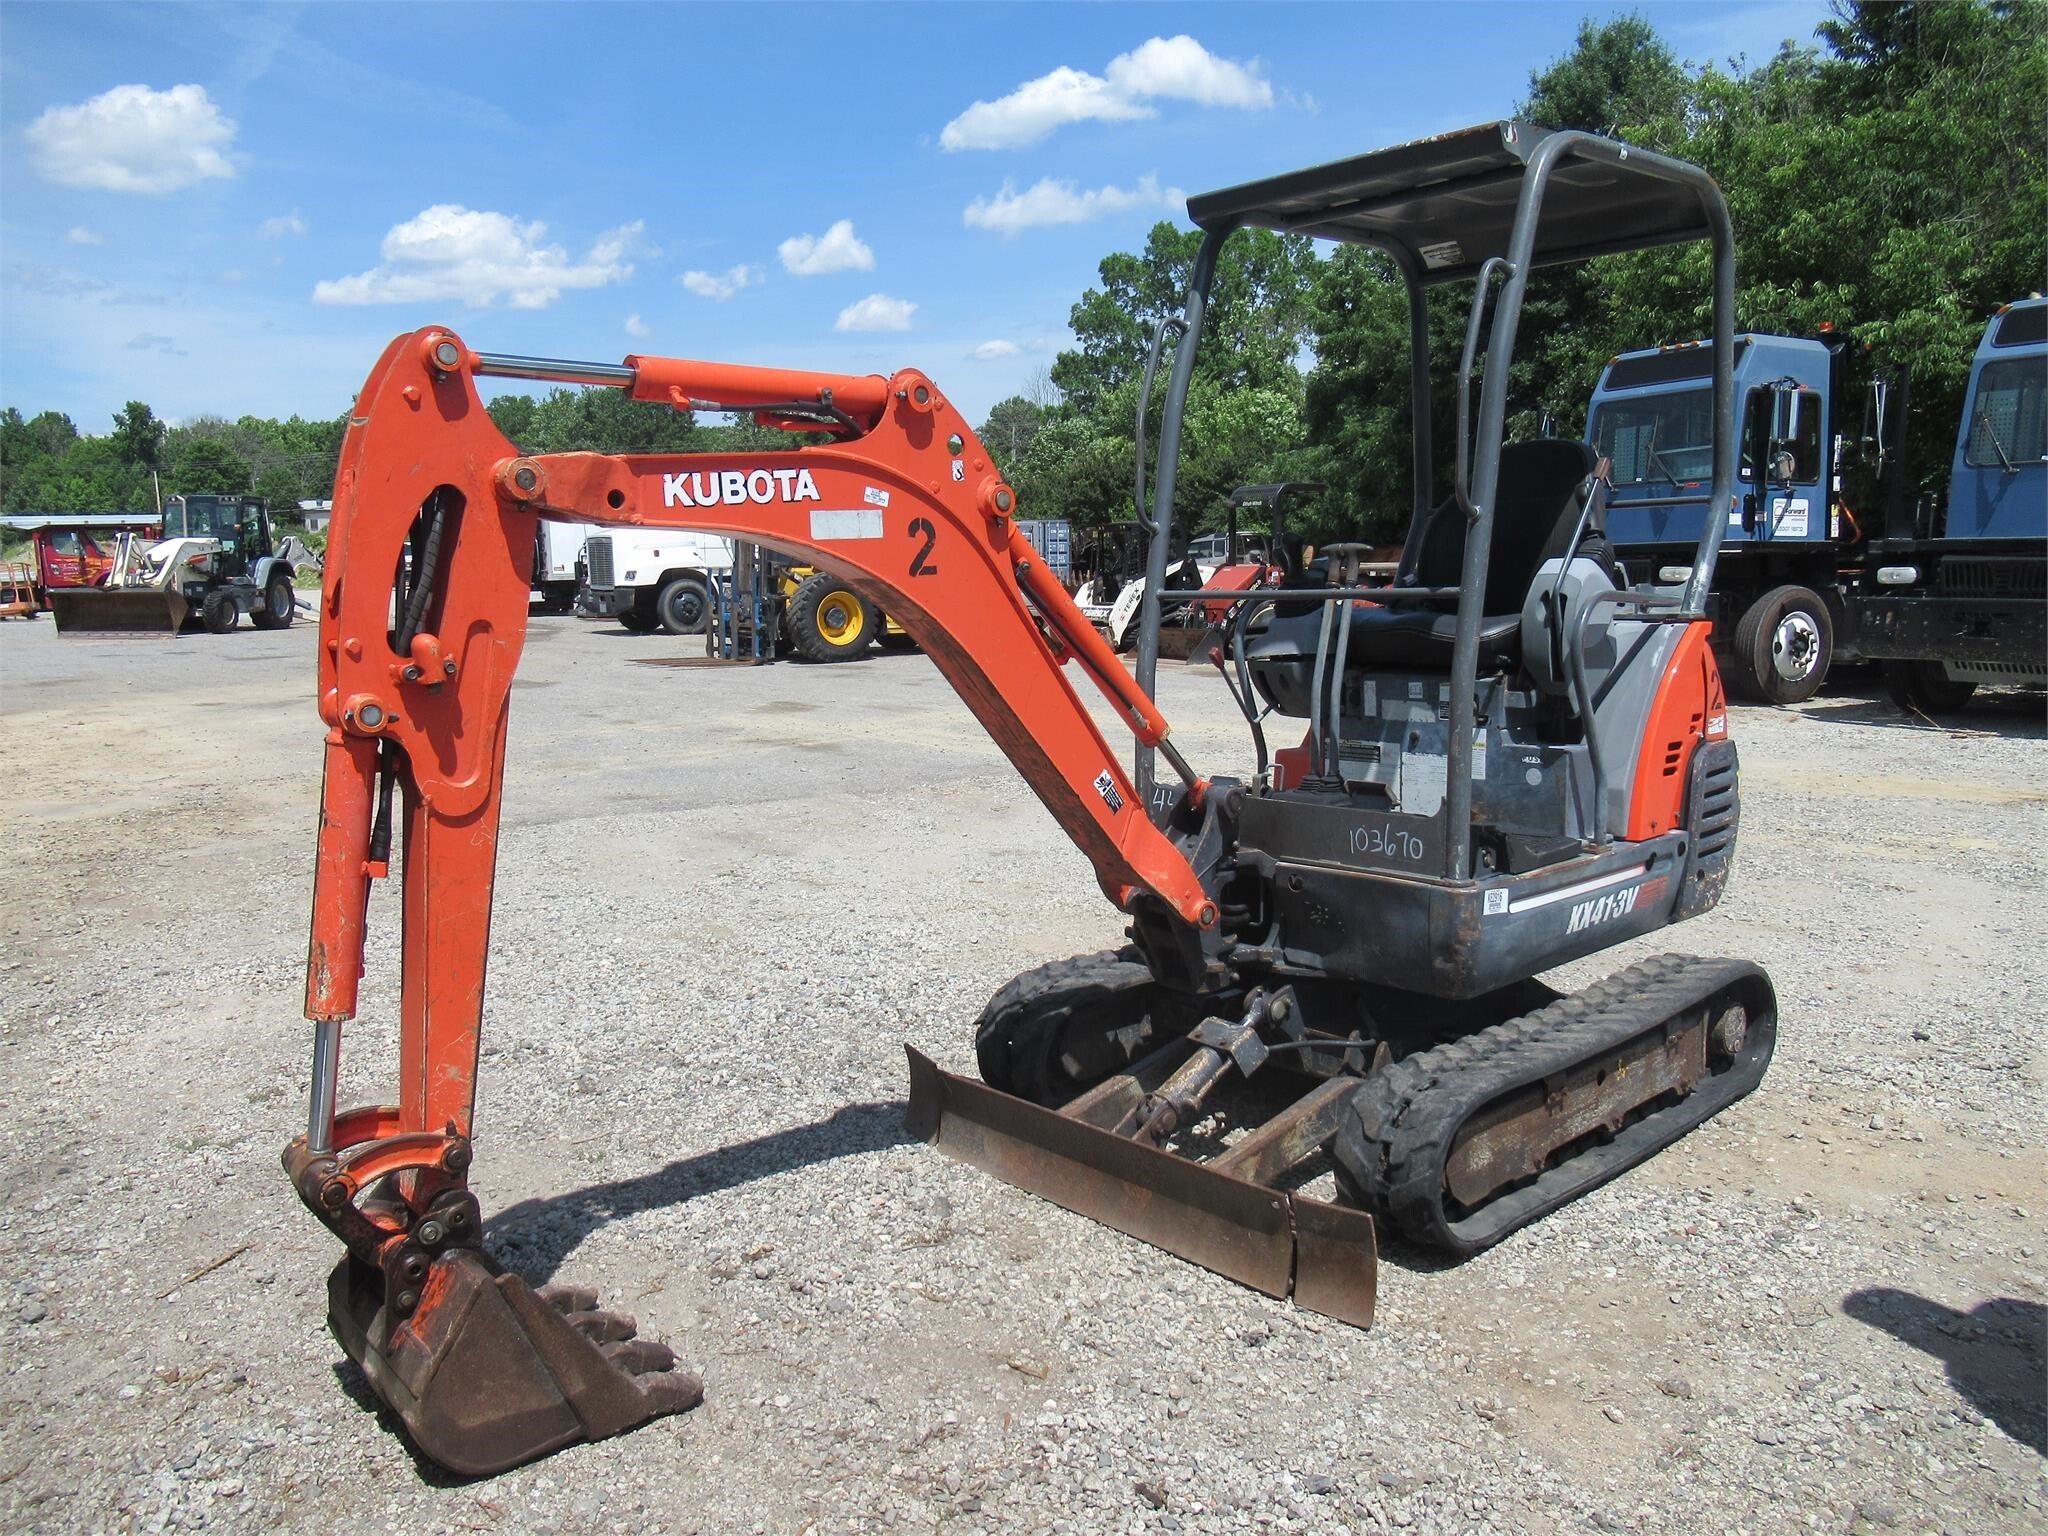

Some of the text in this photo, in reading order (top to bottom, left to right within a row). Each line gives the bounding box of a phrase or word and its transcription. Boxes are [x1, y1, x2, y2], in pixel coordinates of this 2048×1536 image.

[663, 468, 821, 508] KUBOTA
[907, 516, 938, 578] 2
[1123, 587, 1140, 613] TEREX
[1710, 669, 1722, 711] 2
[1349, 823, 1423, 859] 103670
[1566, 885, 1641, 935] KX41-3V
